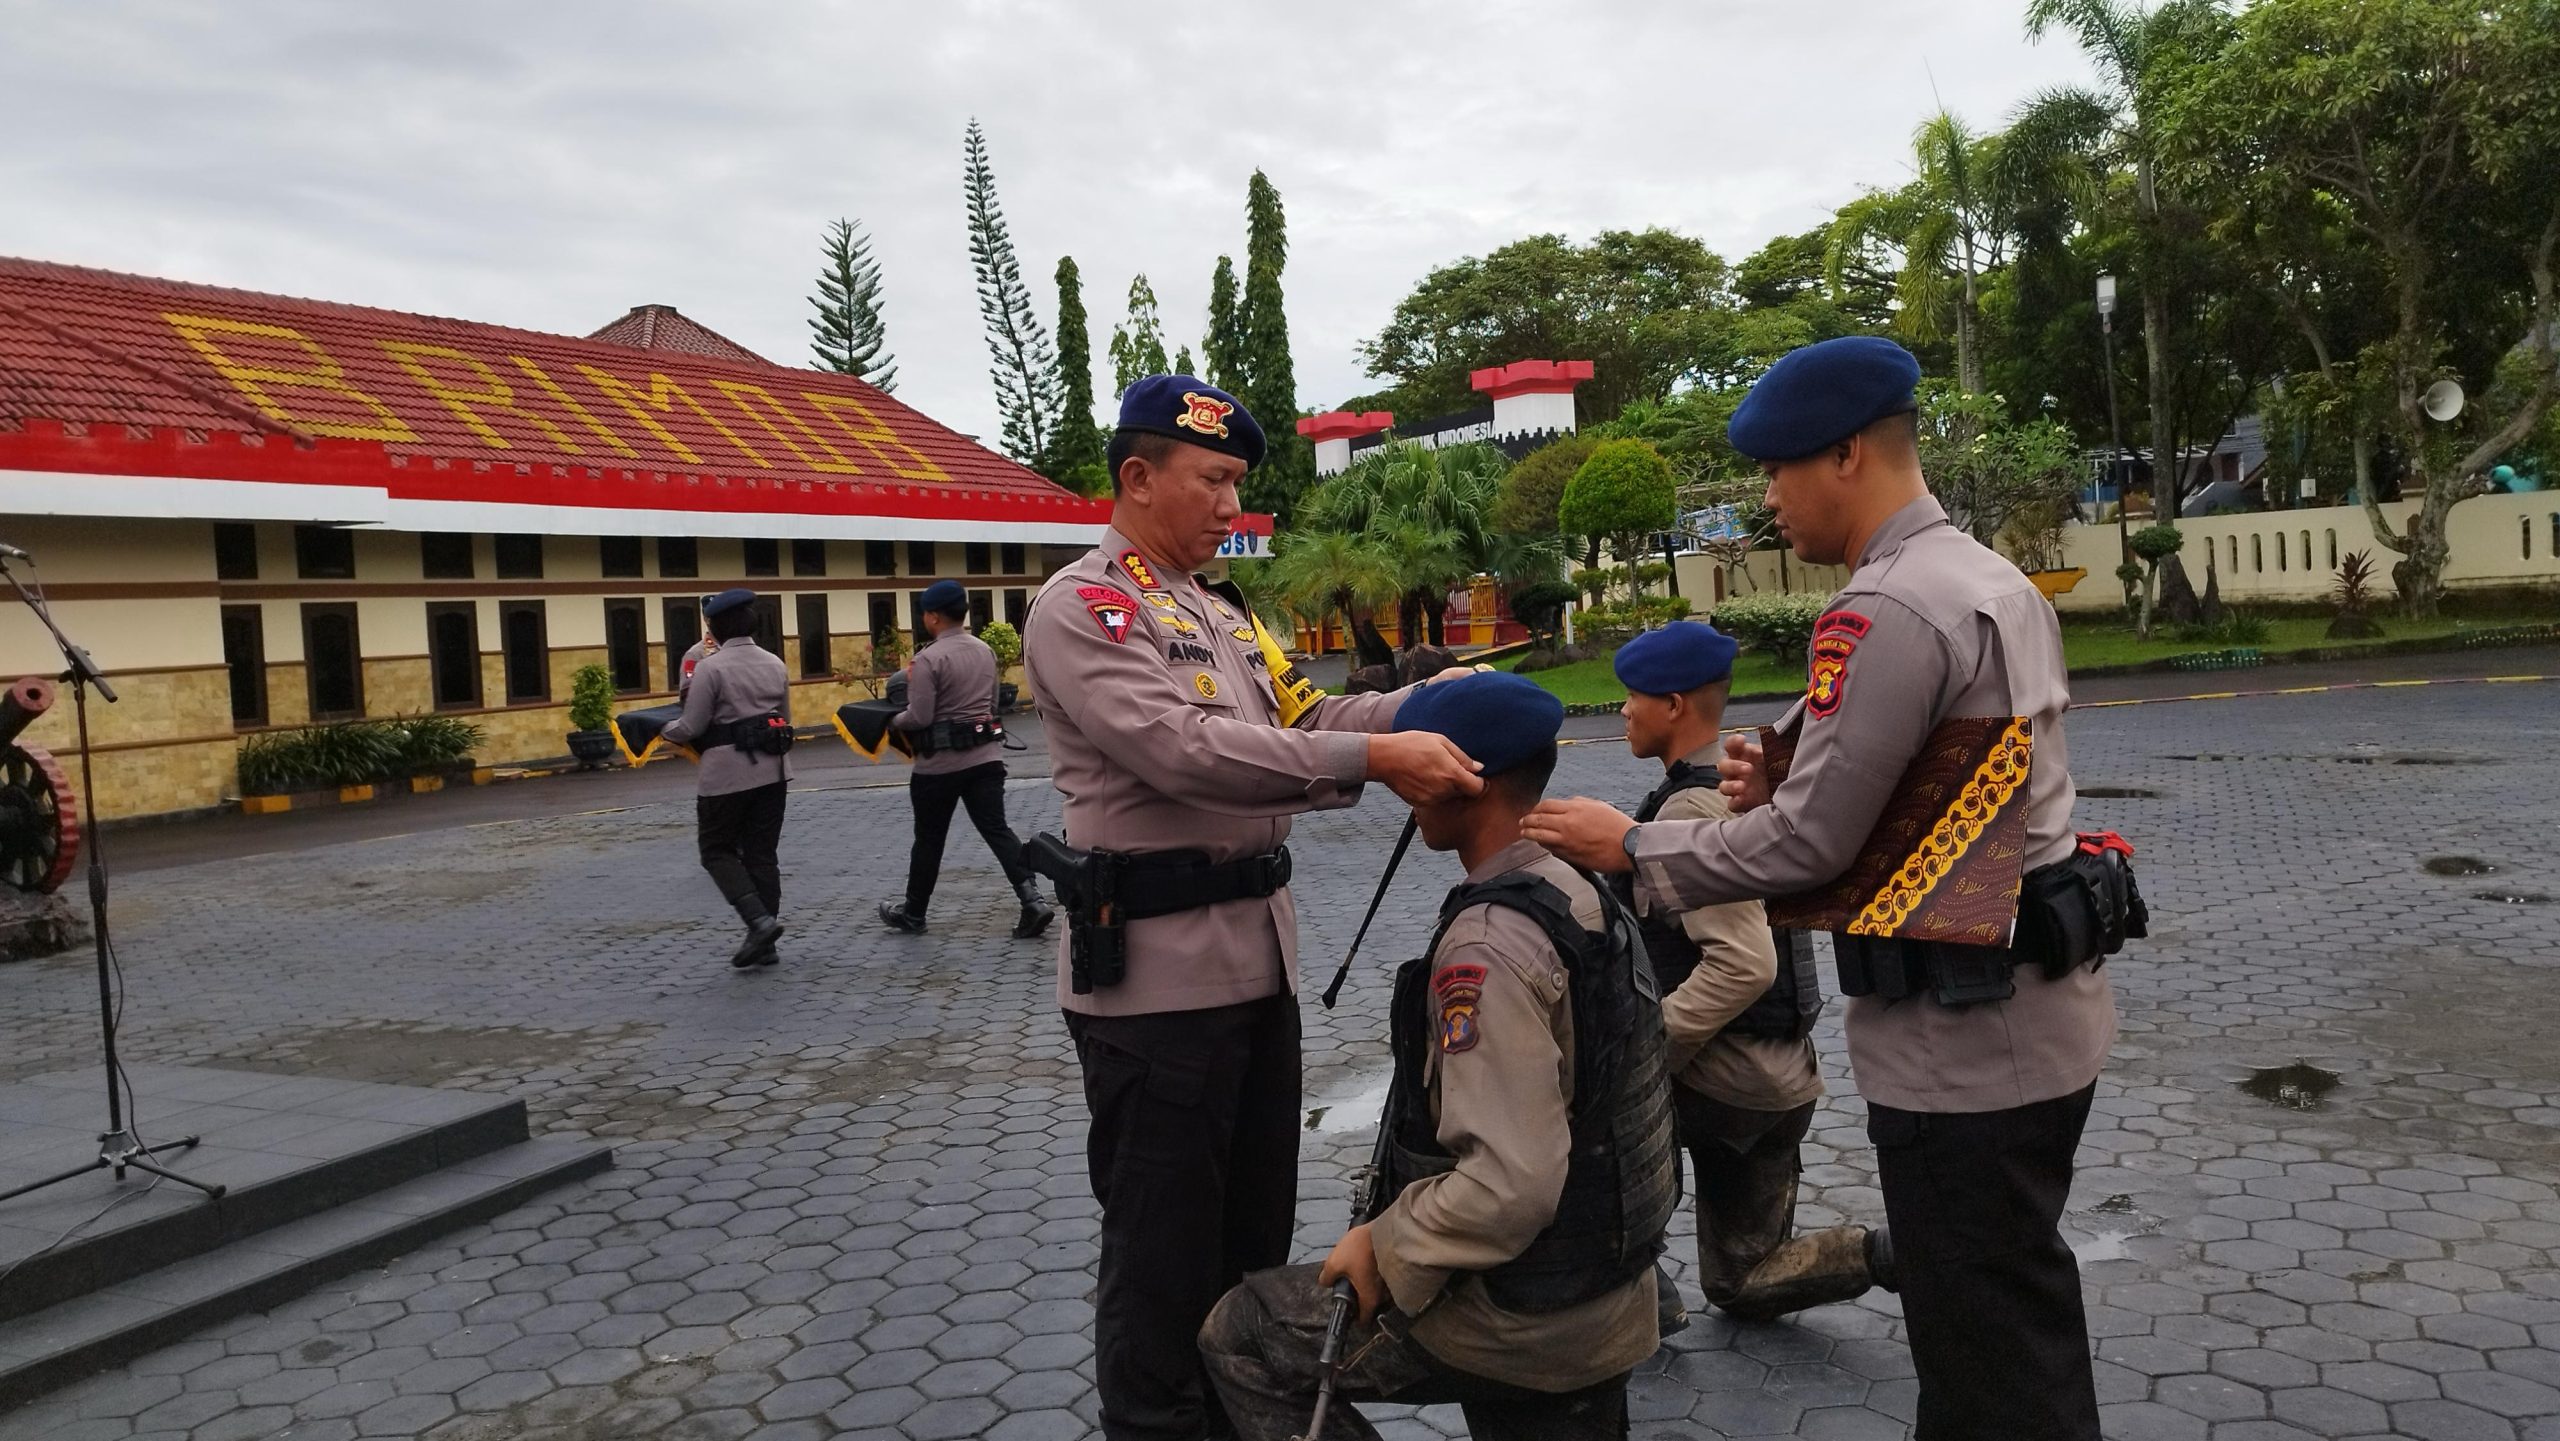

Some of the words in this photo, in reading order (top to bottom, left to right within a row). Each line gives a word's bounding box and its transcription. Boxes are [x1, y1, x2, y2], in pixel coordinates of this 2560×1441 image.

[160, 312, 955, 483] BRIMOB
[1084, 589, 1134, 609] PELOPOR
[1168, 641, 1217, 668] ANDY
